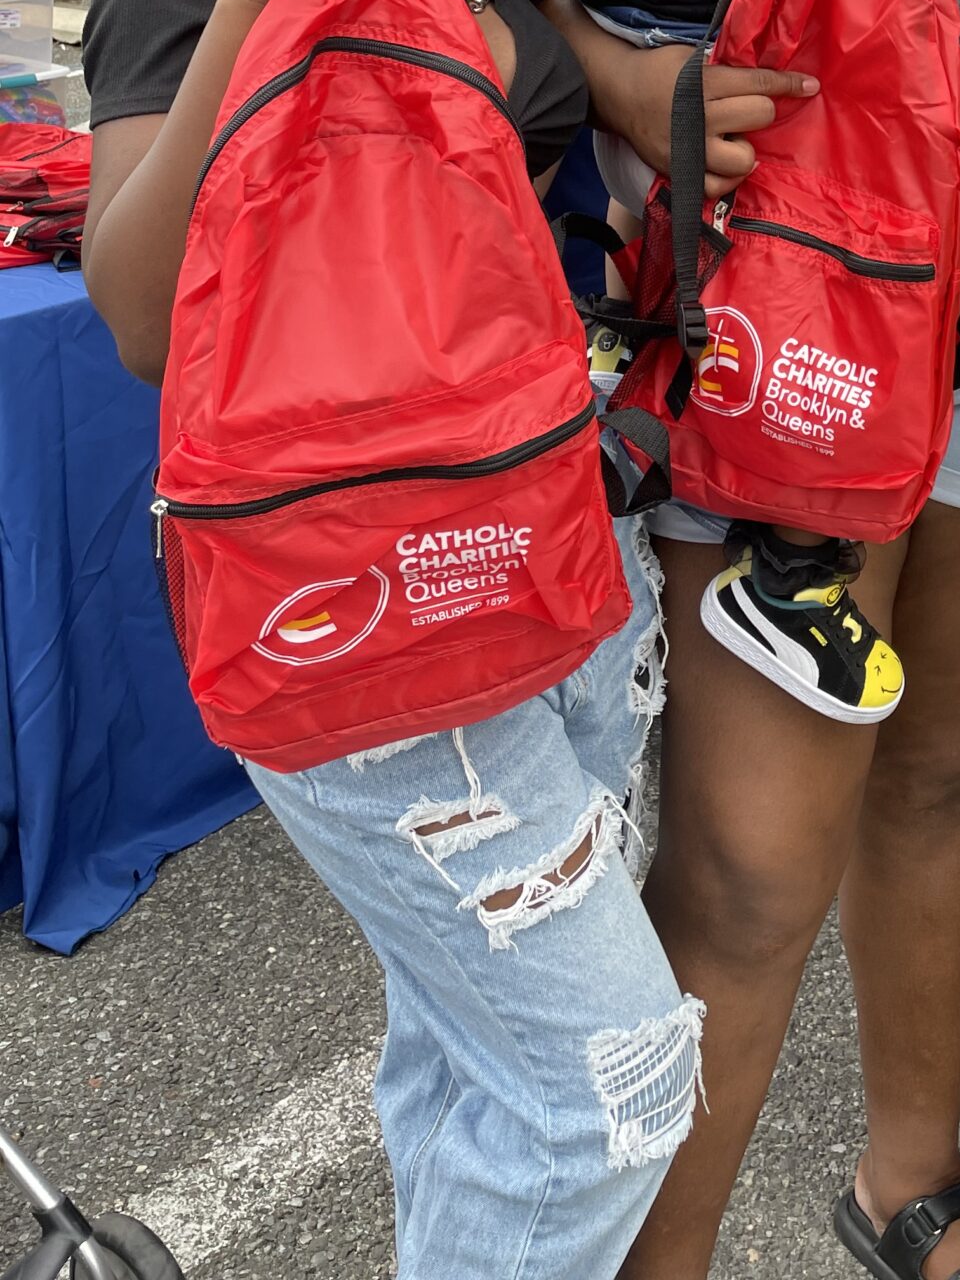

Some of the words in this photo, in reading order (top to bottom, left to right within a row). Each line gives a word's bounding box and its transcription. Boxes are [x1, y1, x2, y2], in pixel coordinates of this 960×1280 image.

[780, 337, 879, 387] CATHOLIC
[772, 358, 873, 409] CHARITIES
[762, 400, 835, 441] Queens
[765, 377, 847, 425] Brooklyn
[849, 408, 866, 430] &
[396, 523, 533, 556] CATHOLC
[399, 539, 528, 574] CHARITIE
[402, 559, 520, 584] Brooklyn
[405, 573, 509, 603] Queens
[485, 595, 510, 607] 1899
